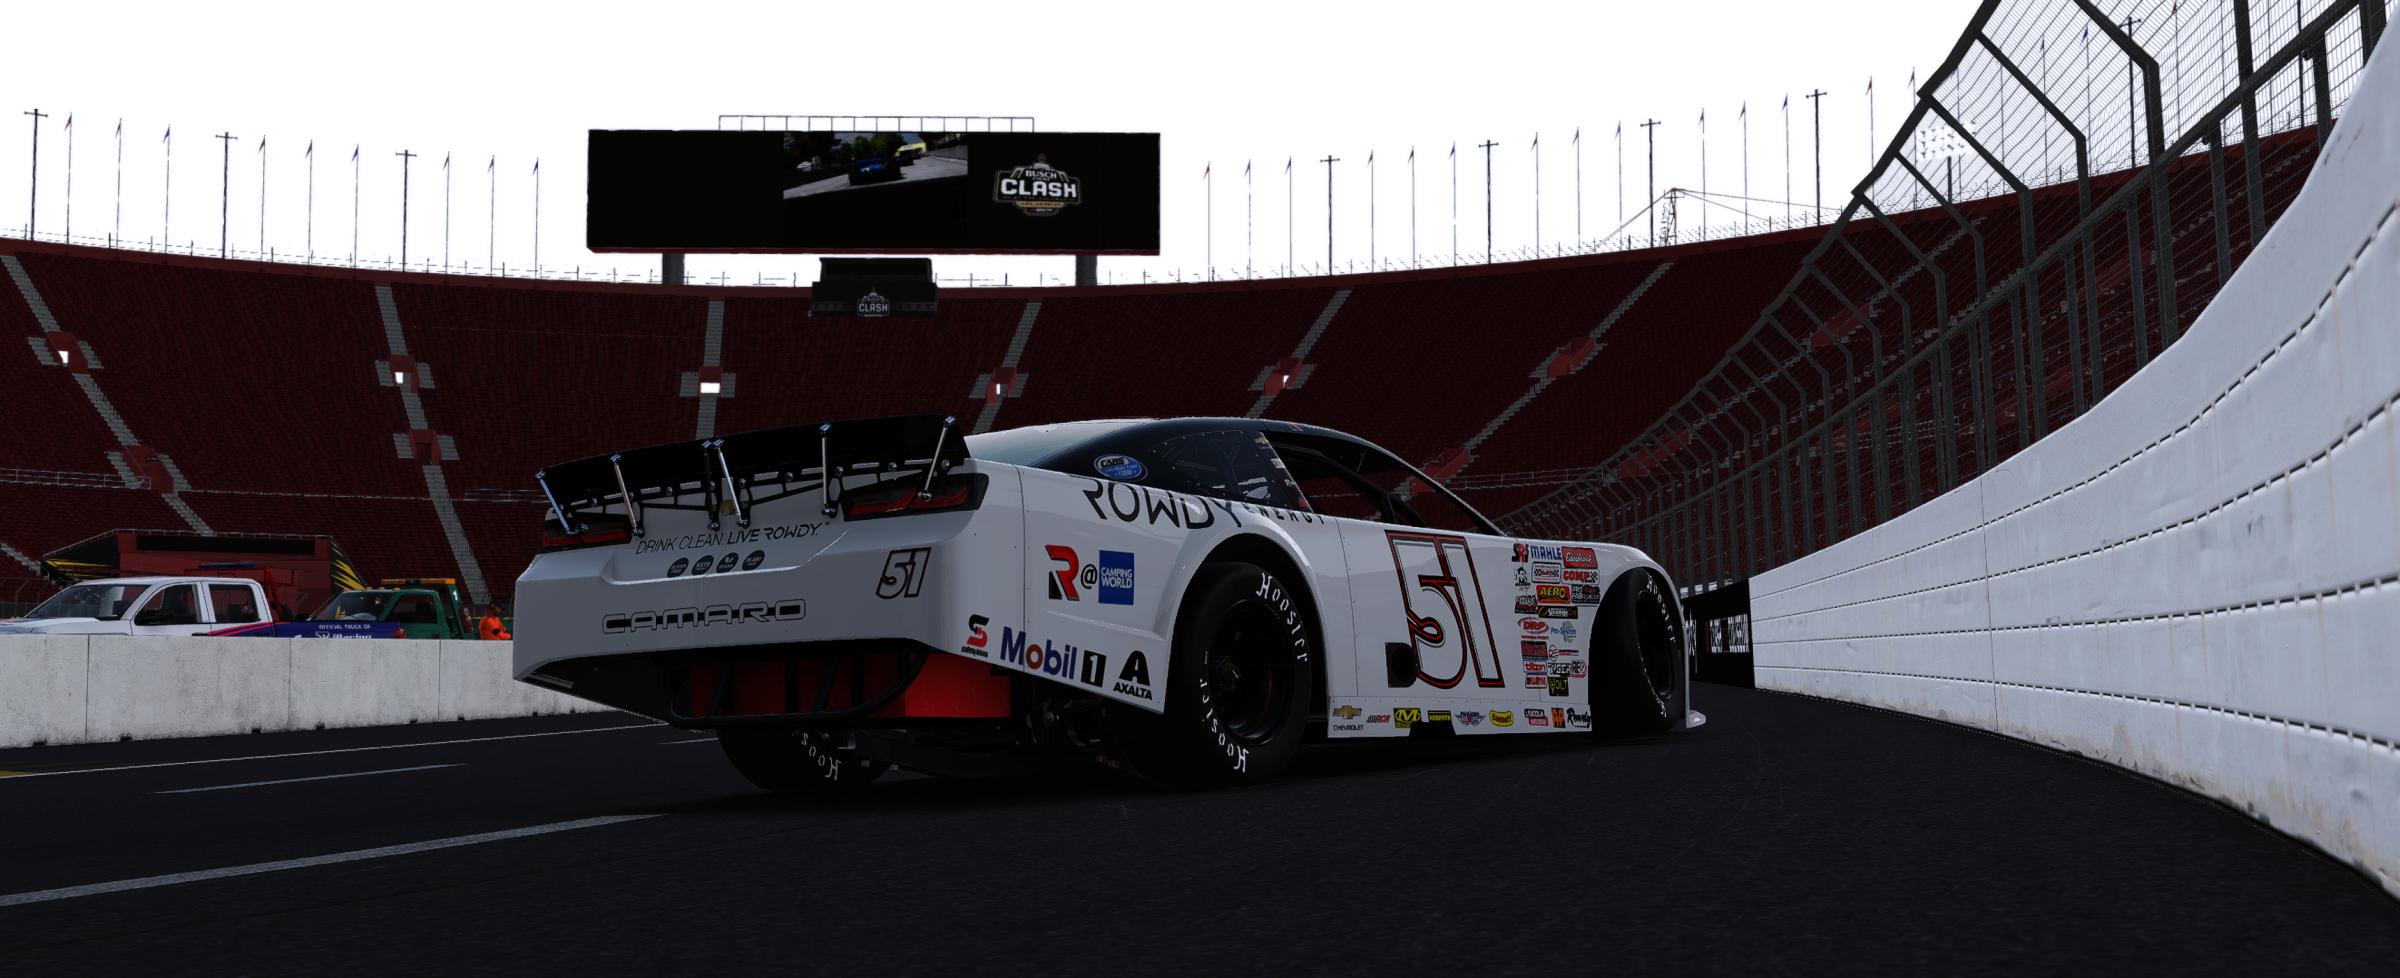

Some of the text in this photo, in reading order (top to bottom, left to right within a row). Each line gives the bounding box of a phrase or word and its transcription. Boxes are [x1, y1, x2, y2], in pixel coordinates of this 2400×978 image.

[1025, 169, 1057, 179] BUSCH
[1001, 178, 1077, 198] CLASH
[858, 303, 888, 312] CLASH
[1100, 457, 1124, 468] CARS
[1082, 476, 1242, 530] ROWDY
[636, 536, 675, 555] DRINK
[727, 528, 763, 546] LIVE
[1530, 545, 1562, 561] MAHLE
[876, 547, 932, 600] 51
[1081, 563, 1098, 589] @
[1101, 566, 1133, 578] CAMPING
[1563, 570, 1590, 581] COMP
[1101, 576, 1133, 589] WORLD
[1540, 586, 1566, 599] AERO
[602, 598, 806, 634] CAMARO
[1384, 529, 1506, 690] 51
[1000, 626, 1077, 680] Mobil
[1113, 682, 1152, 701] AXALTA
